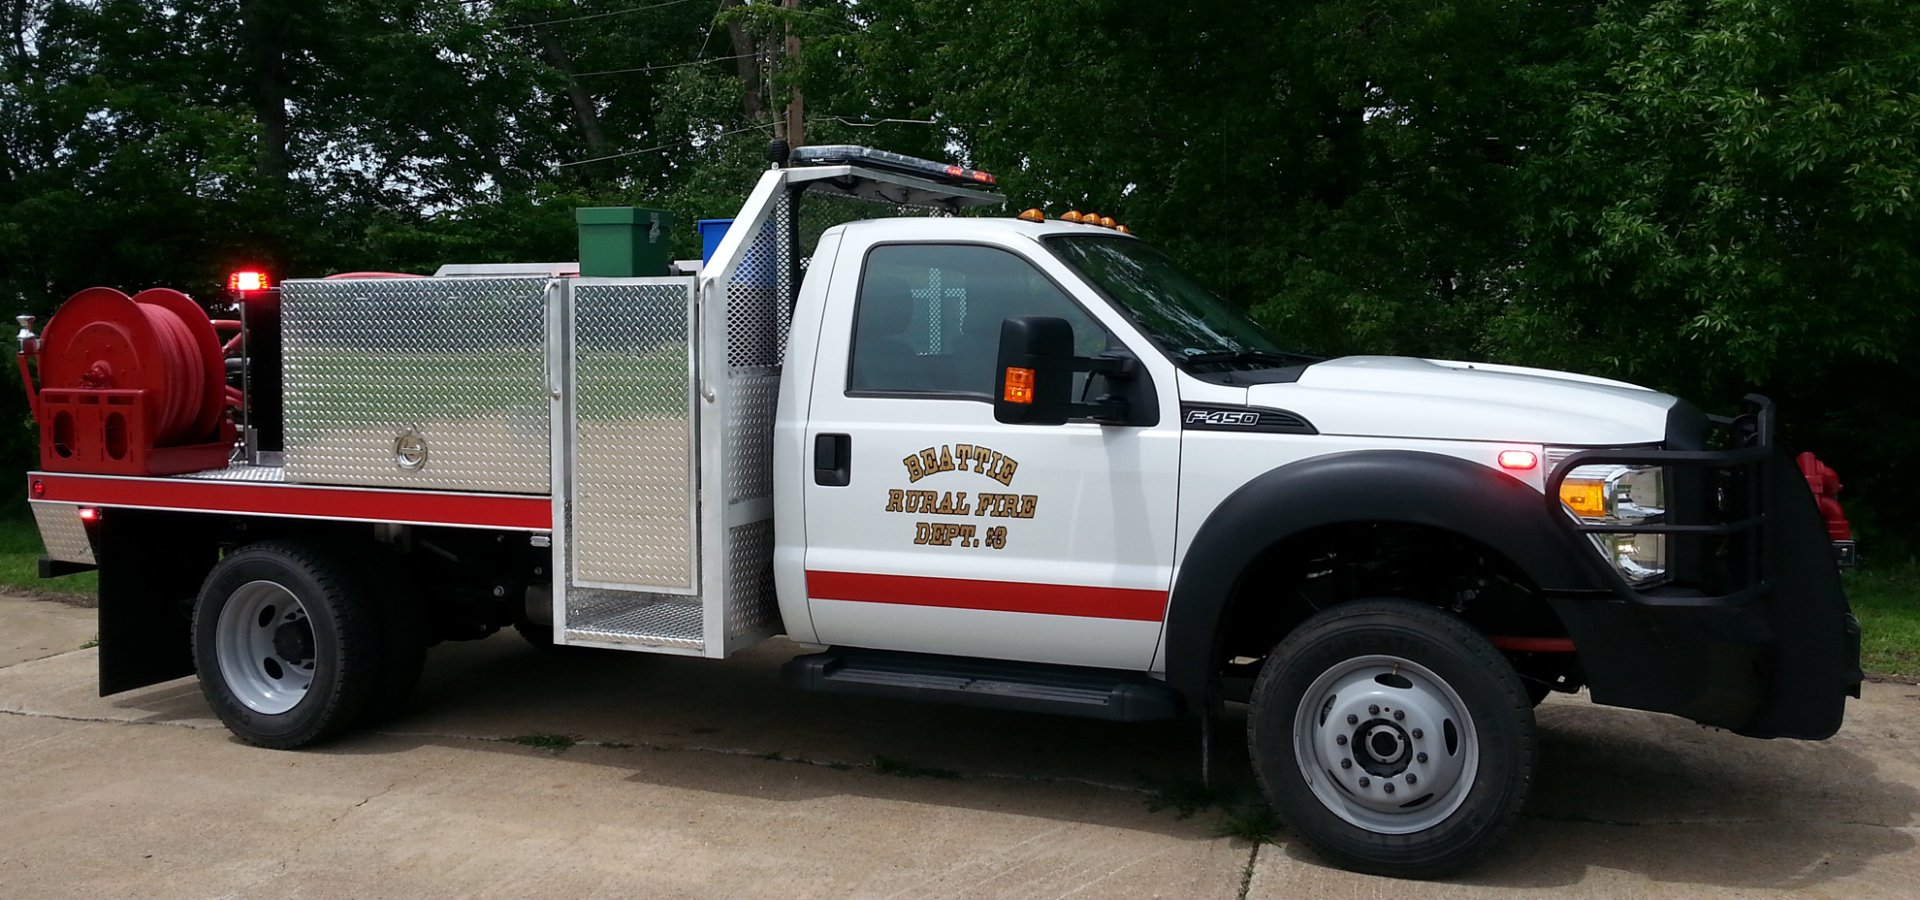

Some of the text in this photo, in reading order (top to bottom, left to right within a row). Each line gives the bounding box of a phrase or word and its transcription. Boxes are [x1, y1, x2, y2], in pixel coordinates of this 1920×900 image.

[1186, 410, 1260, 426] F-450
[903, 443, 1019, 487] BEATTIE
[885, 489, 1038, 519] RURAL FIRE
[914, 522, 1008, 550] DEPT. #3
